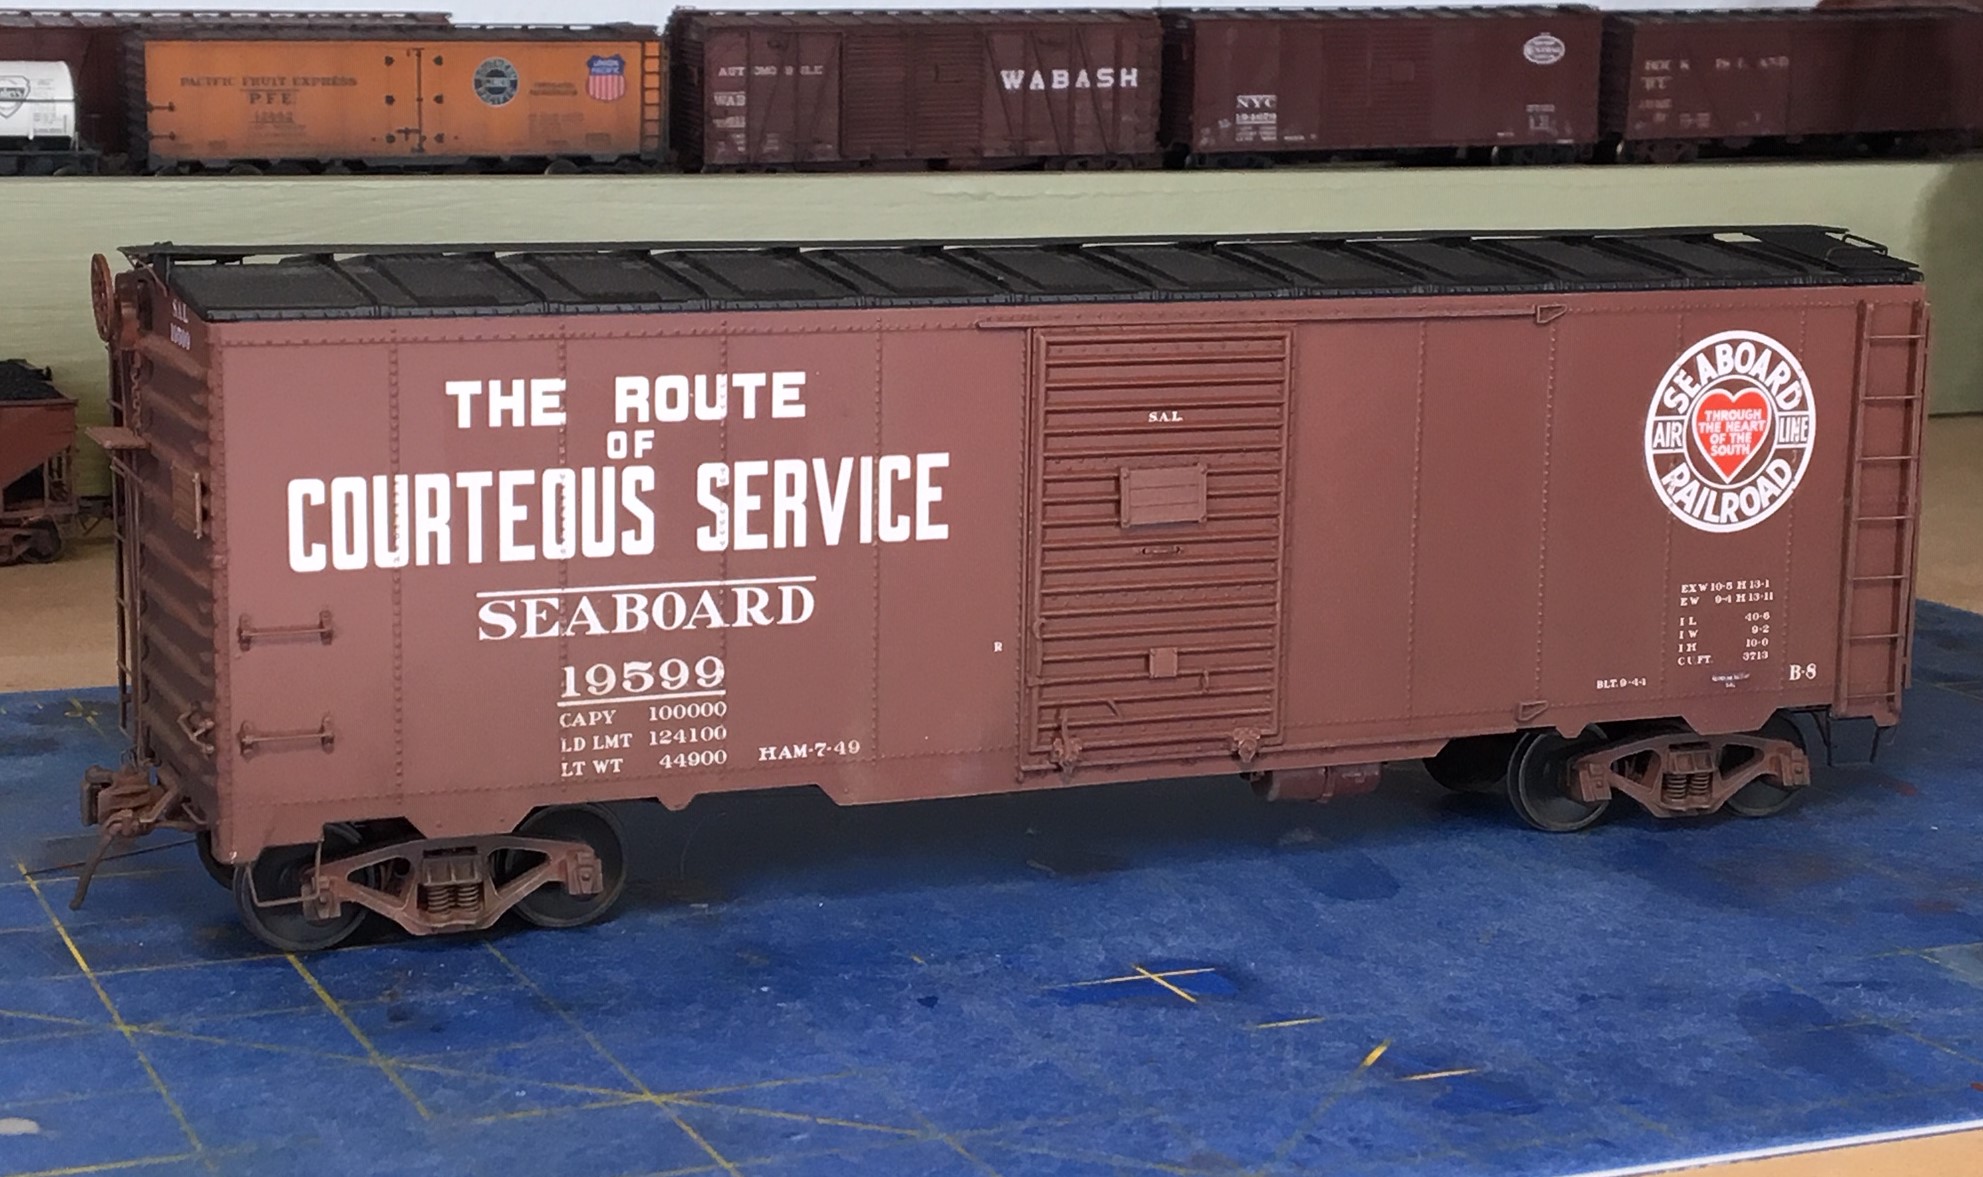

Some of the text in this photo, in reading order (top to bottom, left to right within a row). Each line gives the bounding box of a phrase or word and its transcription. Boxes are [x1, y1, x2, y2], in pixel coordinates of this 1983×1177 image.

[180, 76, 357, 87] PACIFIC FRUIT EXPRESS
[1001, 67, 1138, 91] WABASH
[249, 92, 292, 105] PFE
[1236, 96, 1277, 109] NYC
[1663, 341, 1803, 415] SEABOARD
[446, 371, 806, 429] THE ROUTE
[1704, 408, 1763, 422] THROUGH
[1653, 416, 1809, 449] AIR LINE
[1698, 420, 1767, 434] THE HEART
[606, 429, 655, 460] OF
[1709, 432, 1753, 445] OF THE
[1710, 443, 1751, 457] SOUTH
[1660, 458, 1793, 524] RAILROAD
[287, 452, 950, 573] COURTEOUS SERVICE
[1736, 580, 1747, 590] H
[1735, 593, 1746, 603] H
[478, 585, 816, 641] SEABOARD
[1751, 624, 1770, 635] 9-2
[994, 641, 1003, 653] R
[1745, 637, 1769, 648] 10-0
[1742, 650, 1769, 661] 3713
[560, 655, 726, 698] 19599
[559, 701, 728, 729] CAPY 100000
[561, 725, 728, 753] LD LMT 124100
[758, 739, 861, 762] HAM-7-49
[561, 749, 728, 778] LT WT 44900
